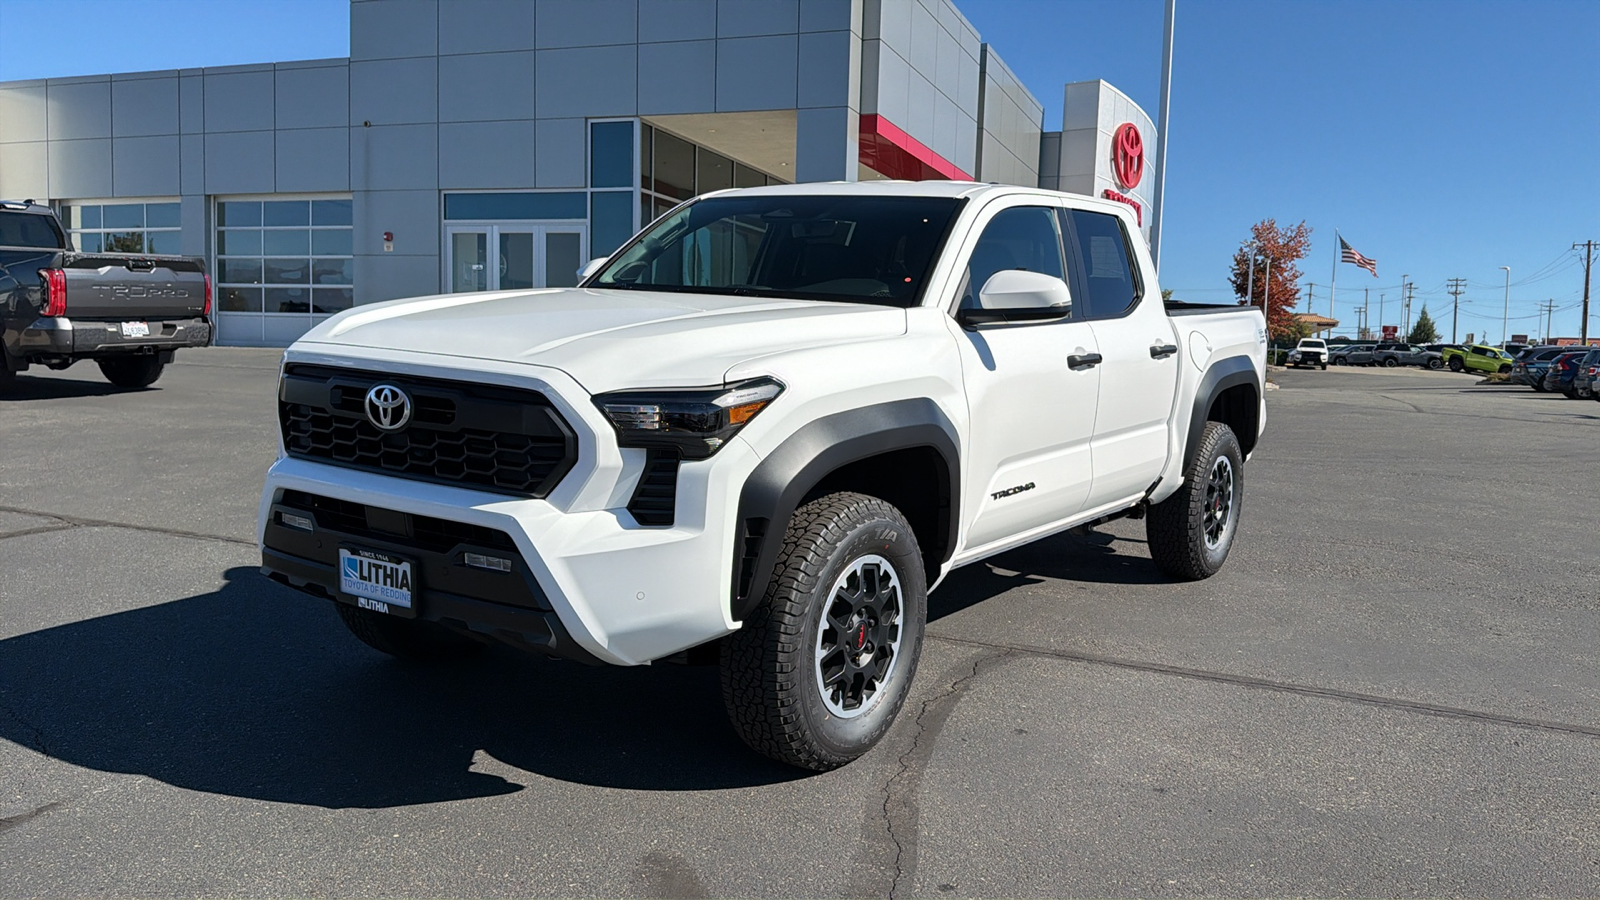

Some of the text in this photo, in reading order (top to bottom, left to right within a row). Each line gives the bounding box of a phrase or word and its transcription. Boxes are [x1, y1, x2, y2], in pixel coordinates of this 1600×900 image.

[1103, 189, 1142, 228] TOTA
[990, 481, 1036, 501] TACOMA
[359, 550, 376, 559] SINCE
[359, 559, 411, 592] LITHIA
[344, 579, 411, 603] TOYOTA OF REDDING
[365, 598, 389, 614] LITHIA
